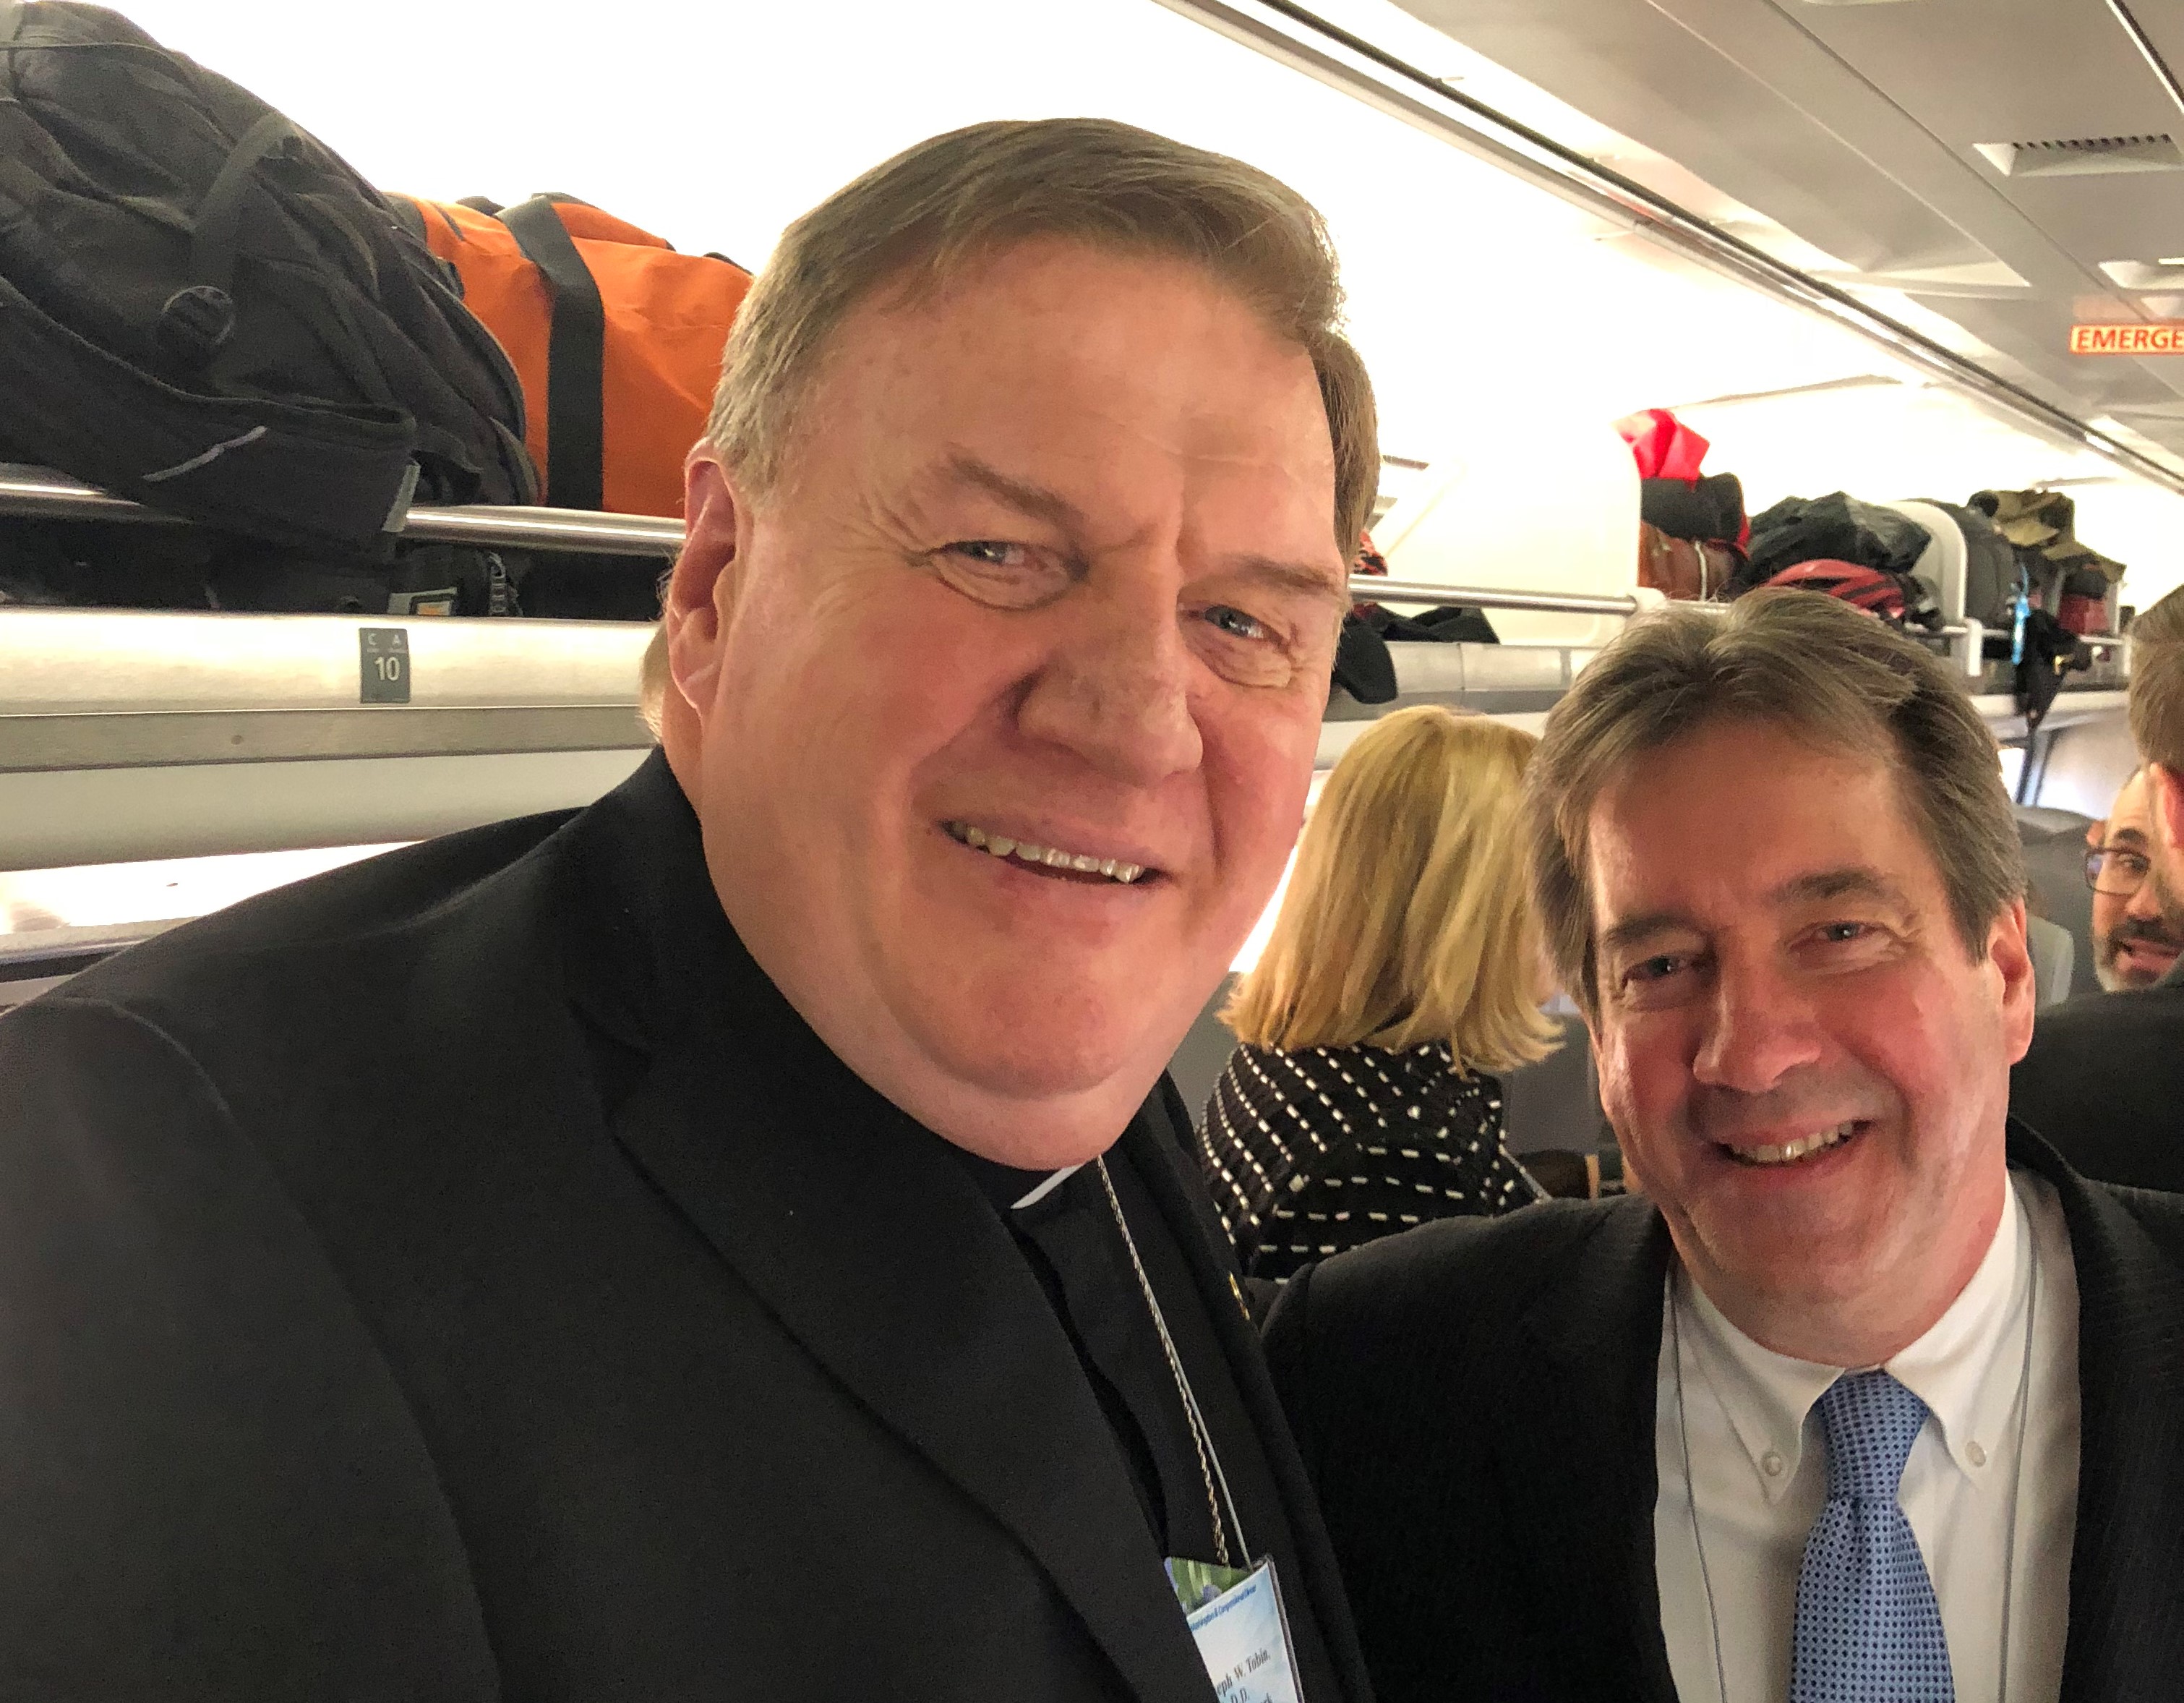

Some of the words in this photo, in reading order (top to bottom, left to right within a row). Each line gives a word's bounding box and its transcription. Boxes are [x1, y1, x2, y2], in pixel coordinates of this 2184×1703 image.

[2077, 328, 2184, 349] EMERGE
[367, 633, 377, 646] C
[392, 634, 402, 646] A
[374, 657, 400, 681] 10
